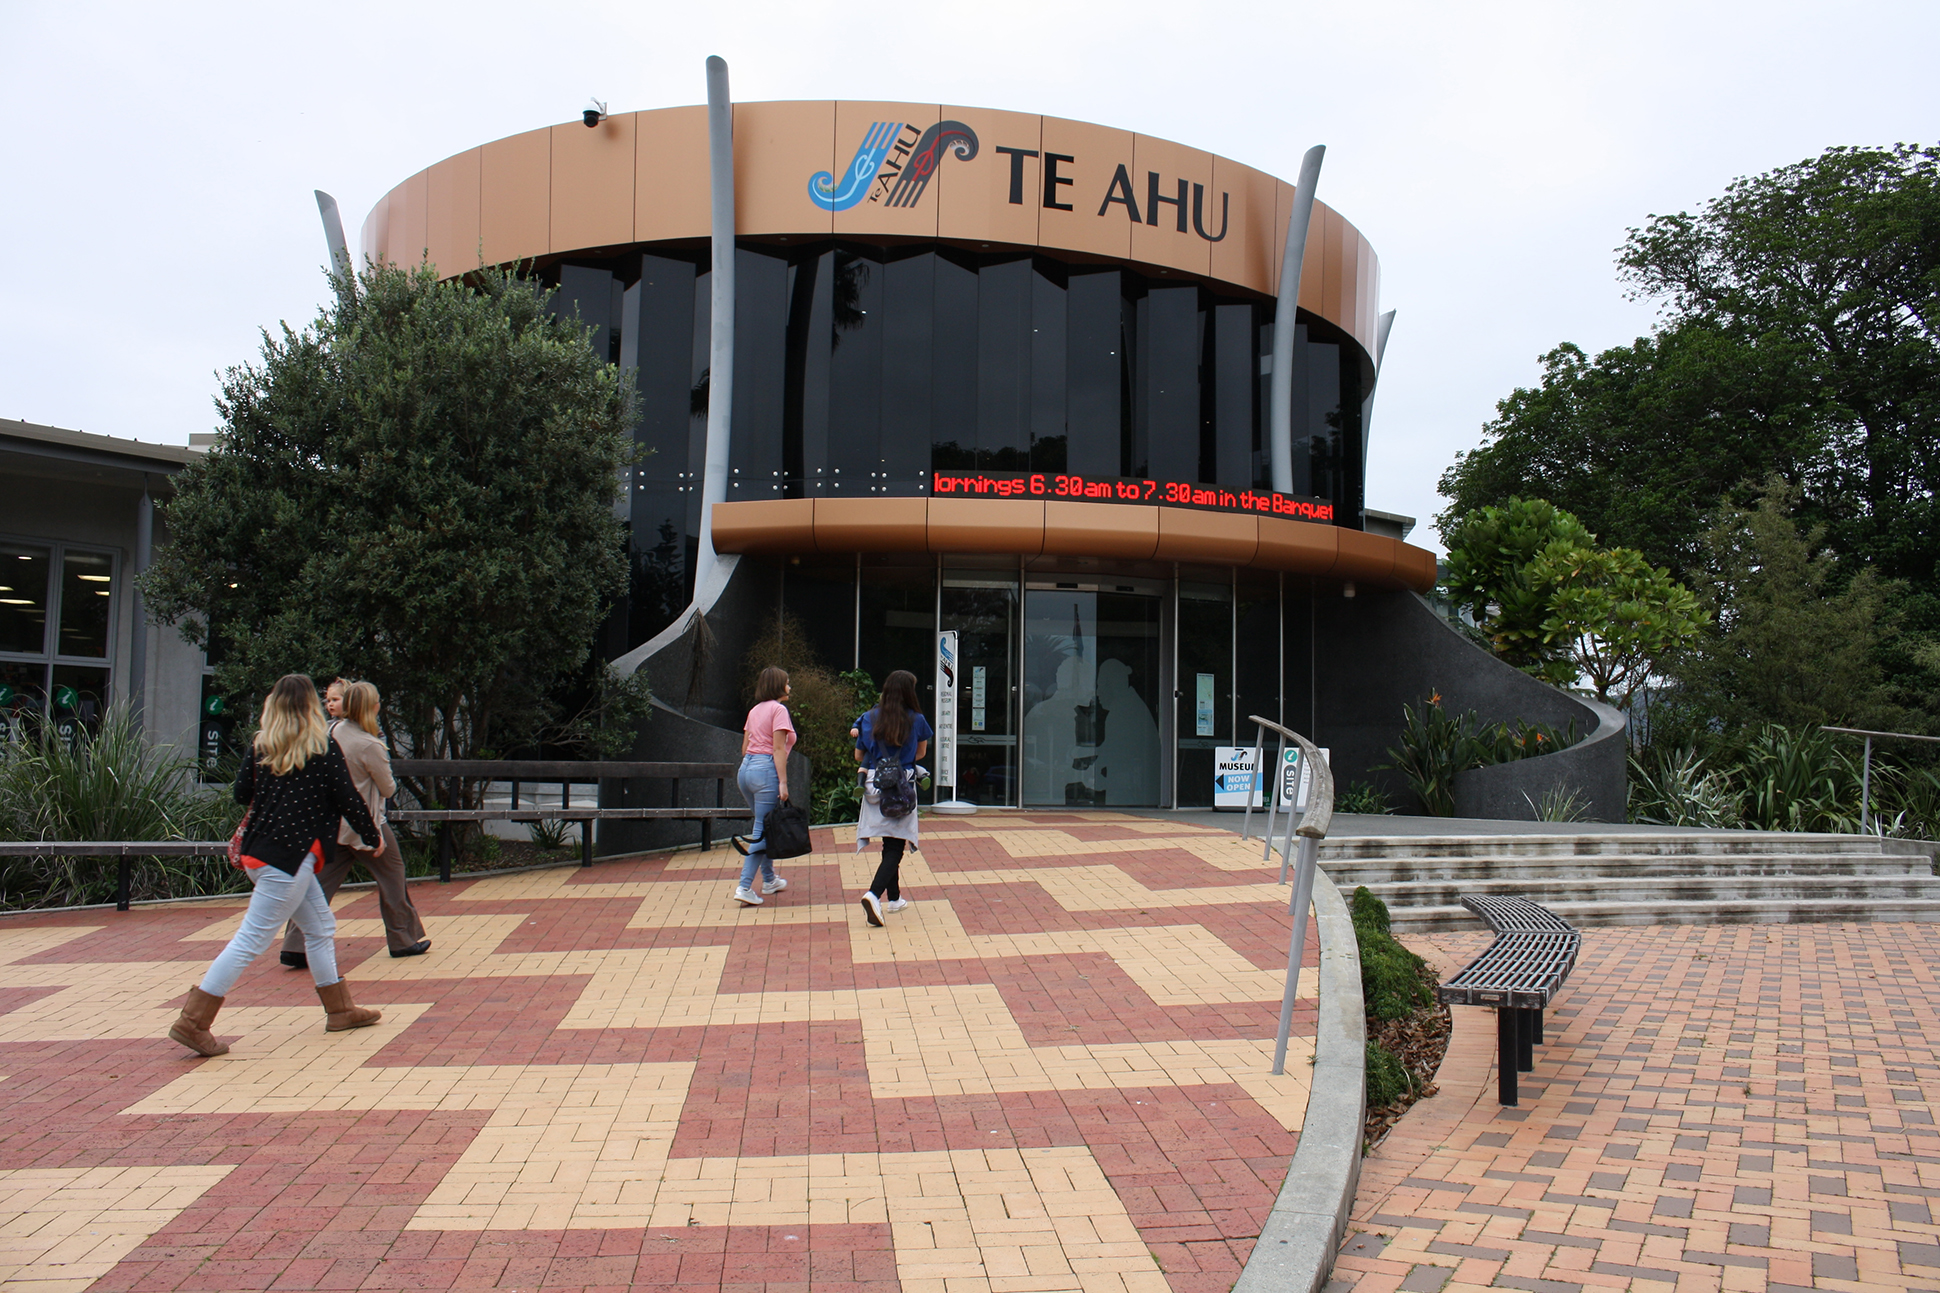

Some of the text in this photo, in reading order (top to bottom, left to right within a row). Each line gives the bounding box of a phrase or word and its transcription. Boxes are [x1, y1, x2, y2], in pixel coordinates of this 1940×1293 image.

[877, 123, 922, 193] AHU
[995, 145, 1229, 243] TE AHU
[1029, 474, 1112, 498] 6.30am
[1115, 480, 1140, 500] to
[1142, 480, 1217, 506] 7.30am
[1219, 489, 1237, 508] in
[1240, 490, 1270, 512] the
[1272, 493, 1334, 521] Banquet
[1226, 782, 1251, 791] OPEN
[1227, 775, 1250, 783] NOW
